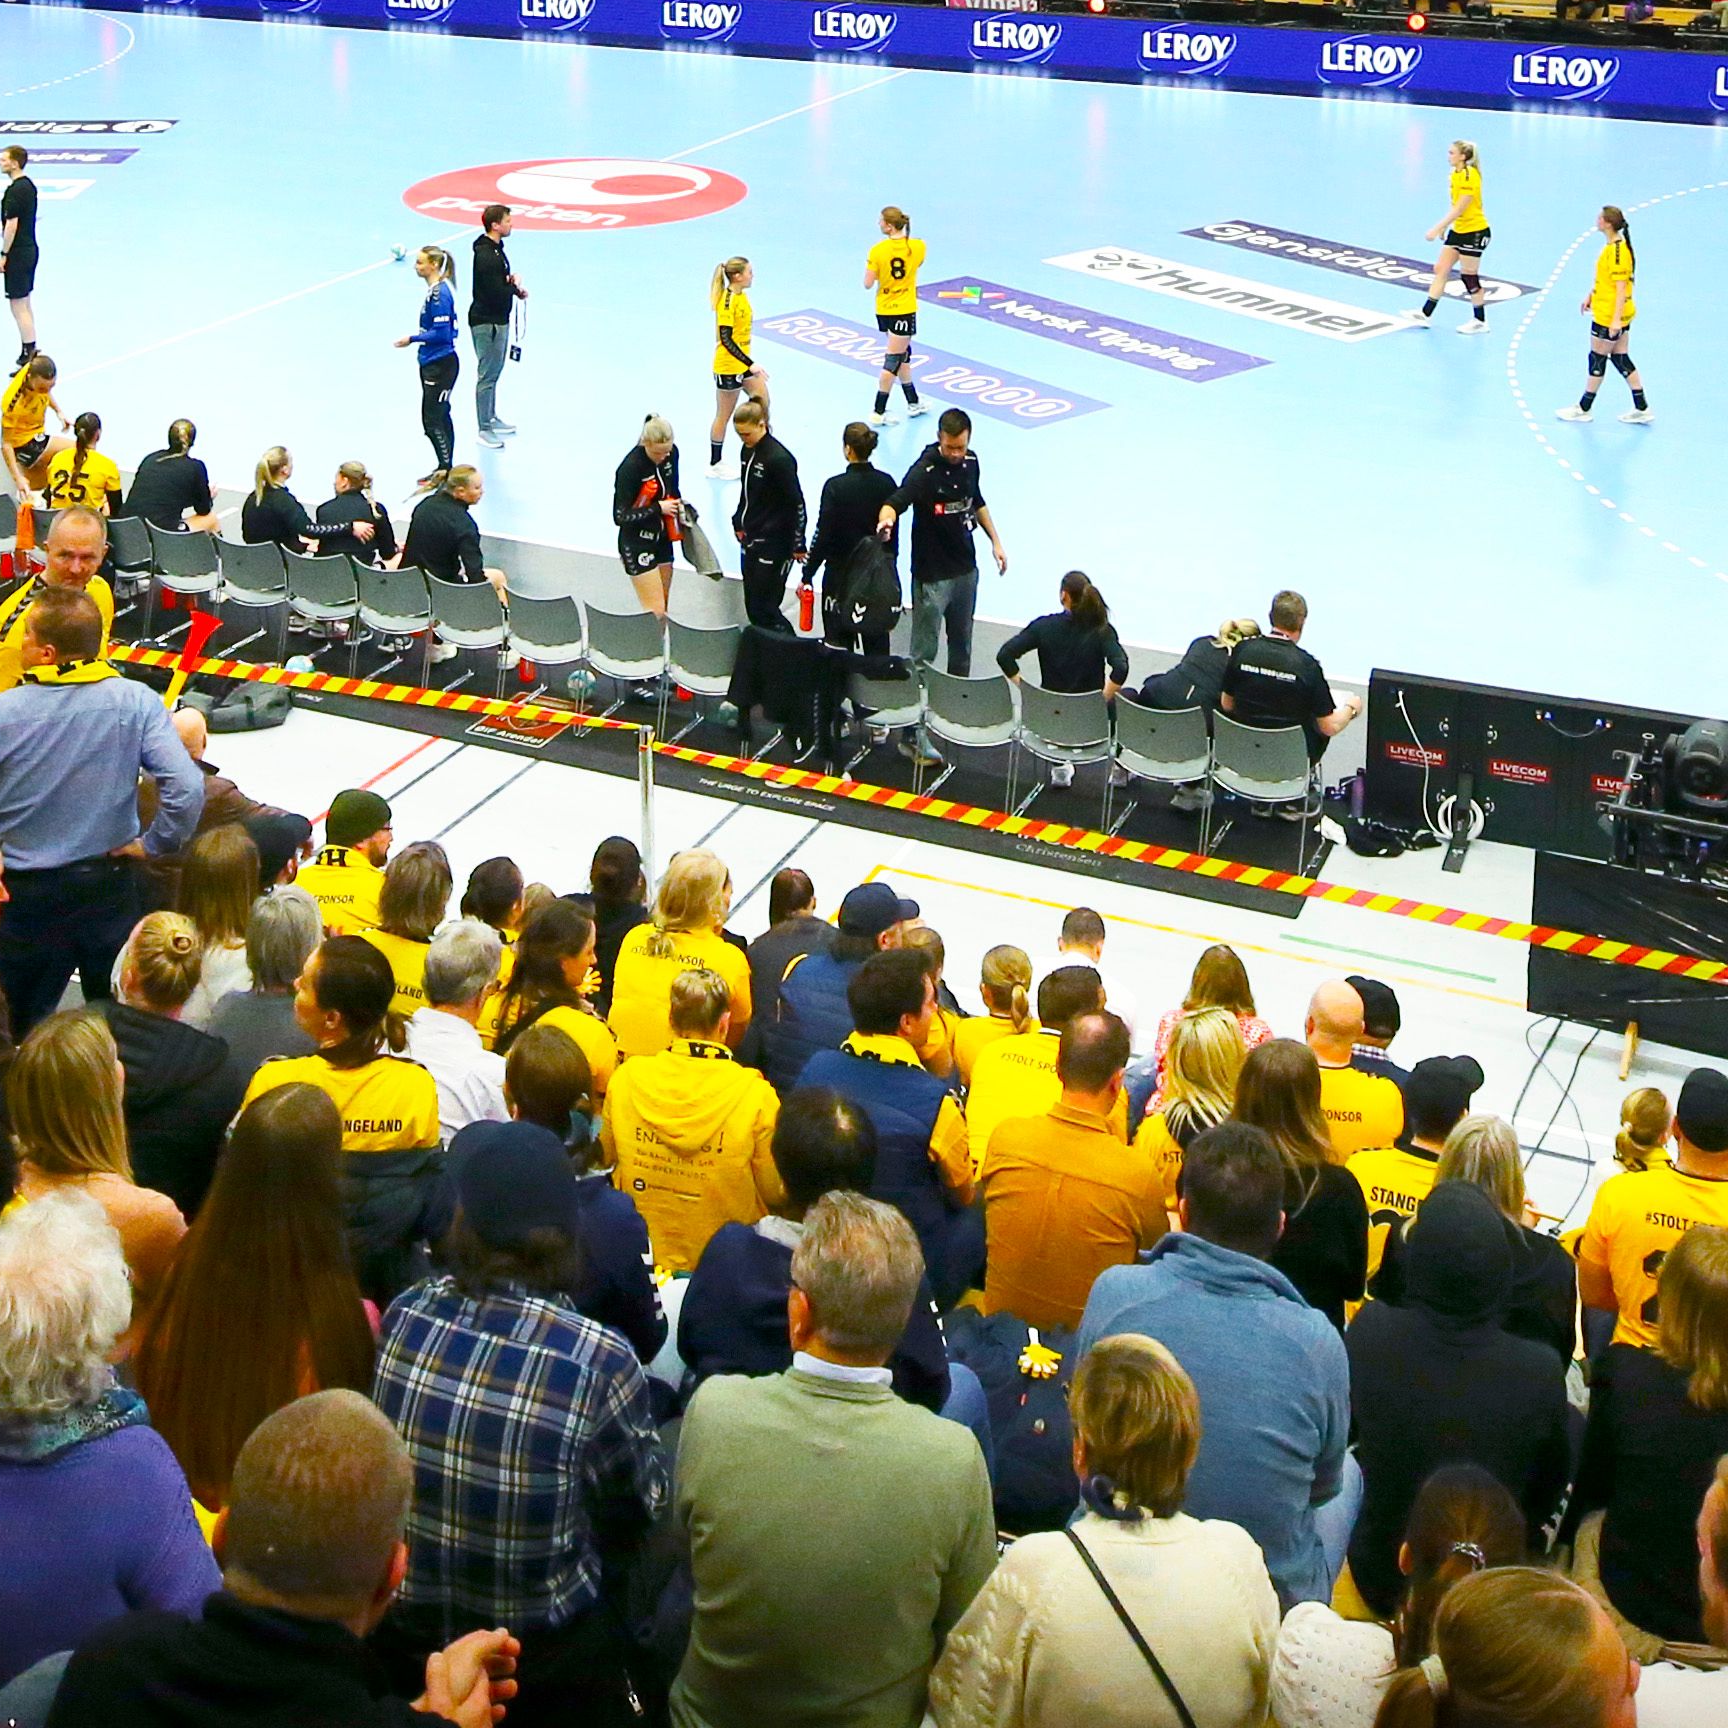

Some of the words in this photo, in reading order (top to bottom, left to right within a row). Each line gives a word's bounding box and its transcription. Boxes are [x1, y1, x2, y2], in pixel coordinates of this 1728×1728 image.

[664, 1, 739, 31] LERØY
[814, 11, 891, 39] LERØY
[973, 21, 1056, 50] LERØY
[1143, 30, 1229, 62] LERØY
[1322, 42, 1415, 74] LERØY
[1512, 54, 1612, 87] LERØY
[1203, 221, 1438, 287] Gjensidige
[890, 257, 905, 280] 8
[1154, 270, 1393, 339] hummel
[990, 296, 1078, 334] Norsk
[1083, 324, 1217, 370] Tipping
[924, 366, 1073, 419] 1000
[53, 470, 89, 504] 25
[496, 727, 545, 745] Arendal
[1390, 745, 1443, 761] LIVECOM
[1493, 761, 1548, 779] LIVECOM
[745, 786, 759, 796] TO
[760, 789, 803, 806] EXPLORE
[1596, 777, 1624, 793] LIVE
[1016, 843, 1103, 867] Christensen
[394, 985, 423, 1000] LAND
[343, 1119, 403, 1135] NGELAND
